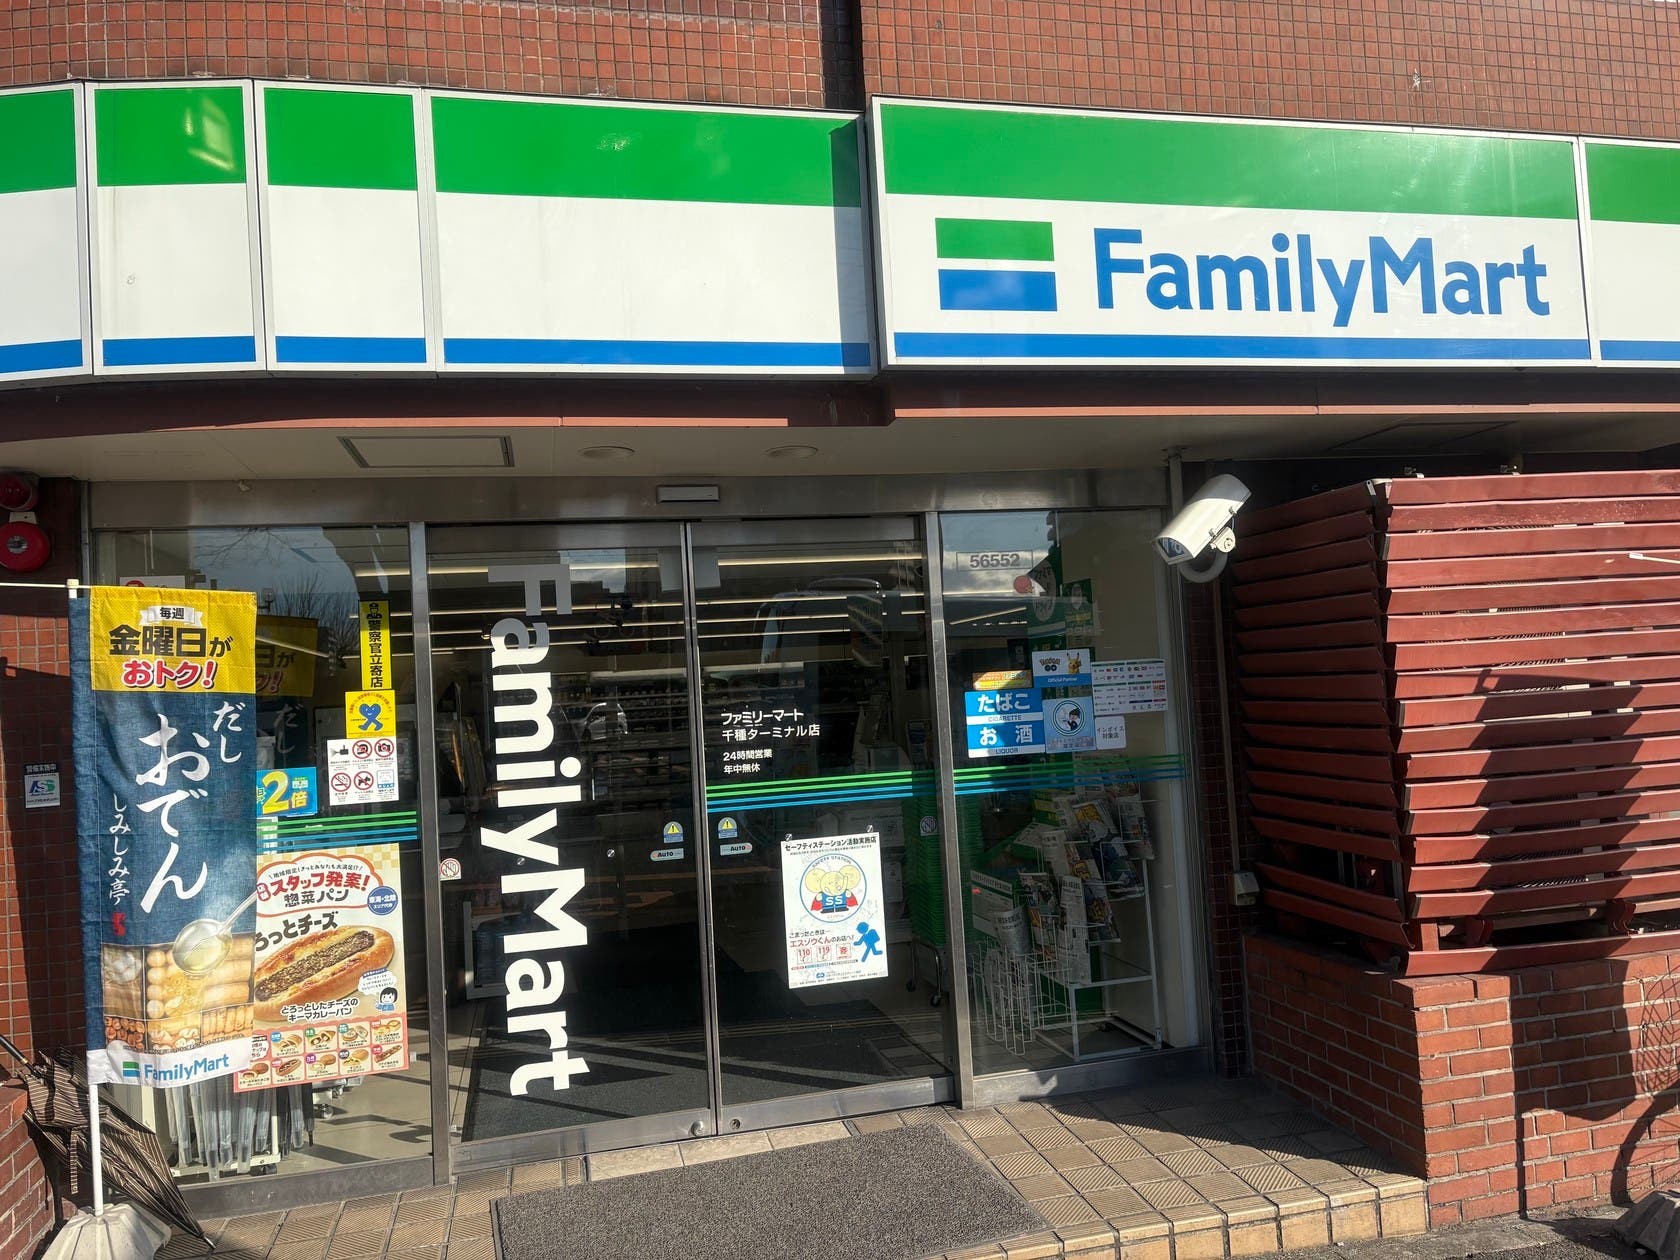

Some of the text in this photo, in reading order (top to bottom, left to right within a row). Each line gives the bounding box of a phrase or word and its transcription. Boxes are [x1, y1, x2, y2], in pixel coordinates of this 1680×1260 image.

[1094, 228, 1550, 327] FamilyMart
[969, 553, 1021, 568] 56552
[159, 607, 185, 620] 毎週
[109, 624, 234, 658] 金曜日が
[367, 619, 385, 688] 警察官立寄店
[123, 660, 218, 689] おトク!
[978, 693, 1031, 713] たばこ
[720, 708, 804, 726] ファミリーマート
[988, 714, 1022, 722] CIGARETTE
[213, 700, 246, 763] だし
[721, 723, 820, 743] 千種ターミナル店
[979, 724, 1033, 746] お酒
[723, 749, 773, 762] 24時間営業
[723, 763, 761, 774] 年中無休
[136, 713, 211, 914] おでん
[480, 564, 591, 1096] FamilyMart
[108, 792, 132, 906] しみしみ亭
[785, 836, 877, 852] セーフティステーション活動実施店
[270, 871, 371, 897] スタッフ発案!
[284, 888, 350, 908] 惣菜パン
[826, 895, 843, 906] SS
[281, 998, 358, 1015] とろっとしたチーズの
[288, 1006, 353, 1022] キーマカレーパン
[144, 1053, 230, 1082] FamilyMart
